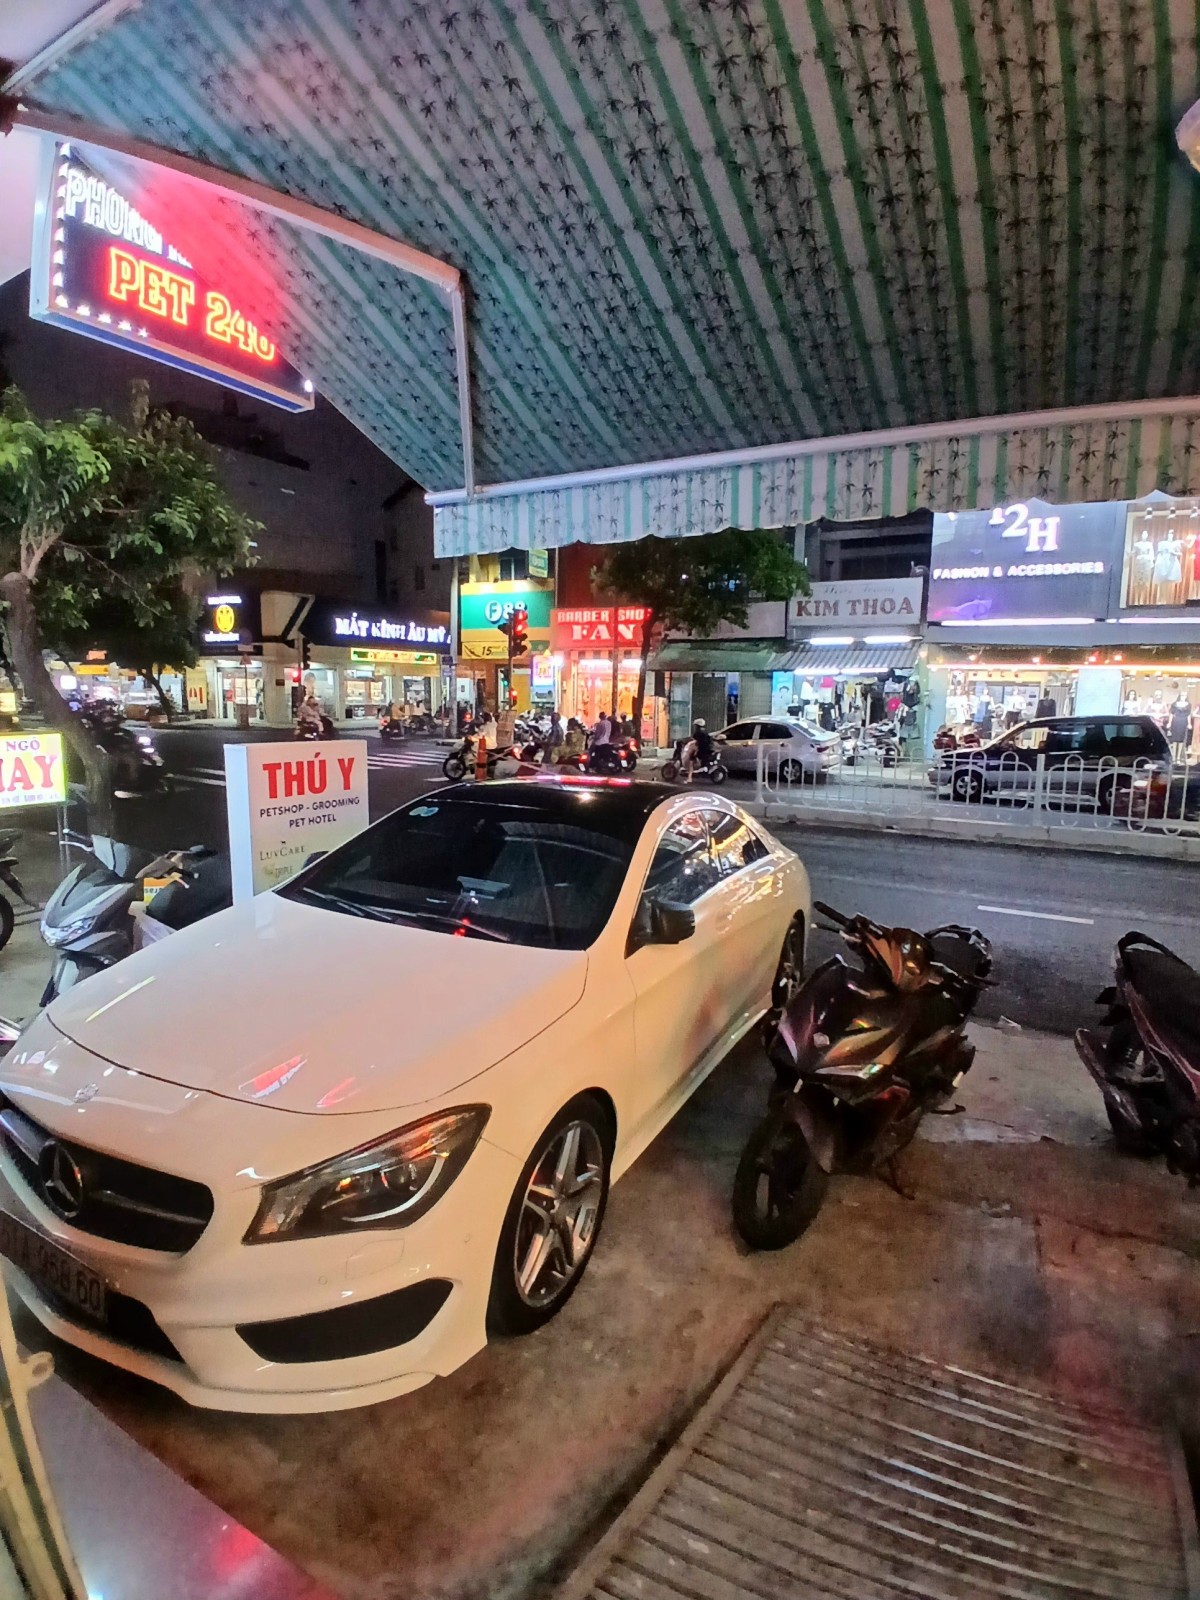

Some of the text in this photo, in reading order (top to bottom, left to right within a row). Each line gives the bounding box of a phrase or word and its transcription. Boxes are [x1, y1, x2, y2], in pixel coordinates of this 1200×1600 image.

[109, 246, 195, 326] PET
[933, 561, 1104, 580] FASHION & ACCESSORIES
[557, 609, 610, 623] BARBER
[796, 597, 914, 617] KIM THOA
[572, 623, 636, 640] FAN
[262, 752, 355, 799] THÚ Y
[260, 803, 304, 818] PETSHOP
[312, 796, 360, 811] GROOMING
[289, 813, 337, 828] PET HOTEL
